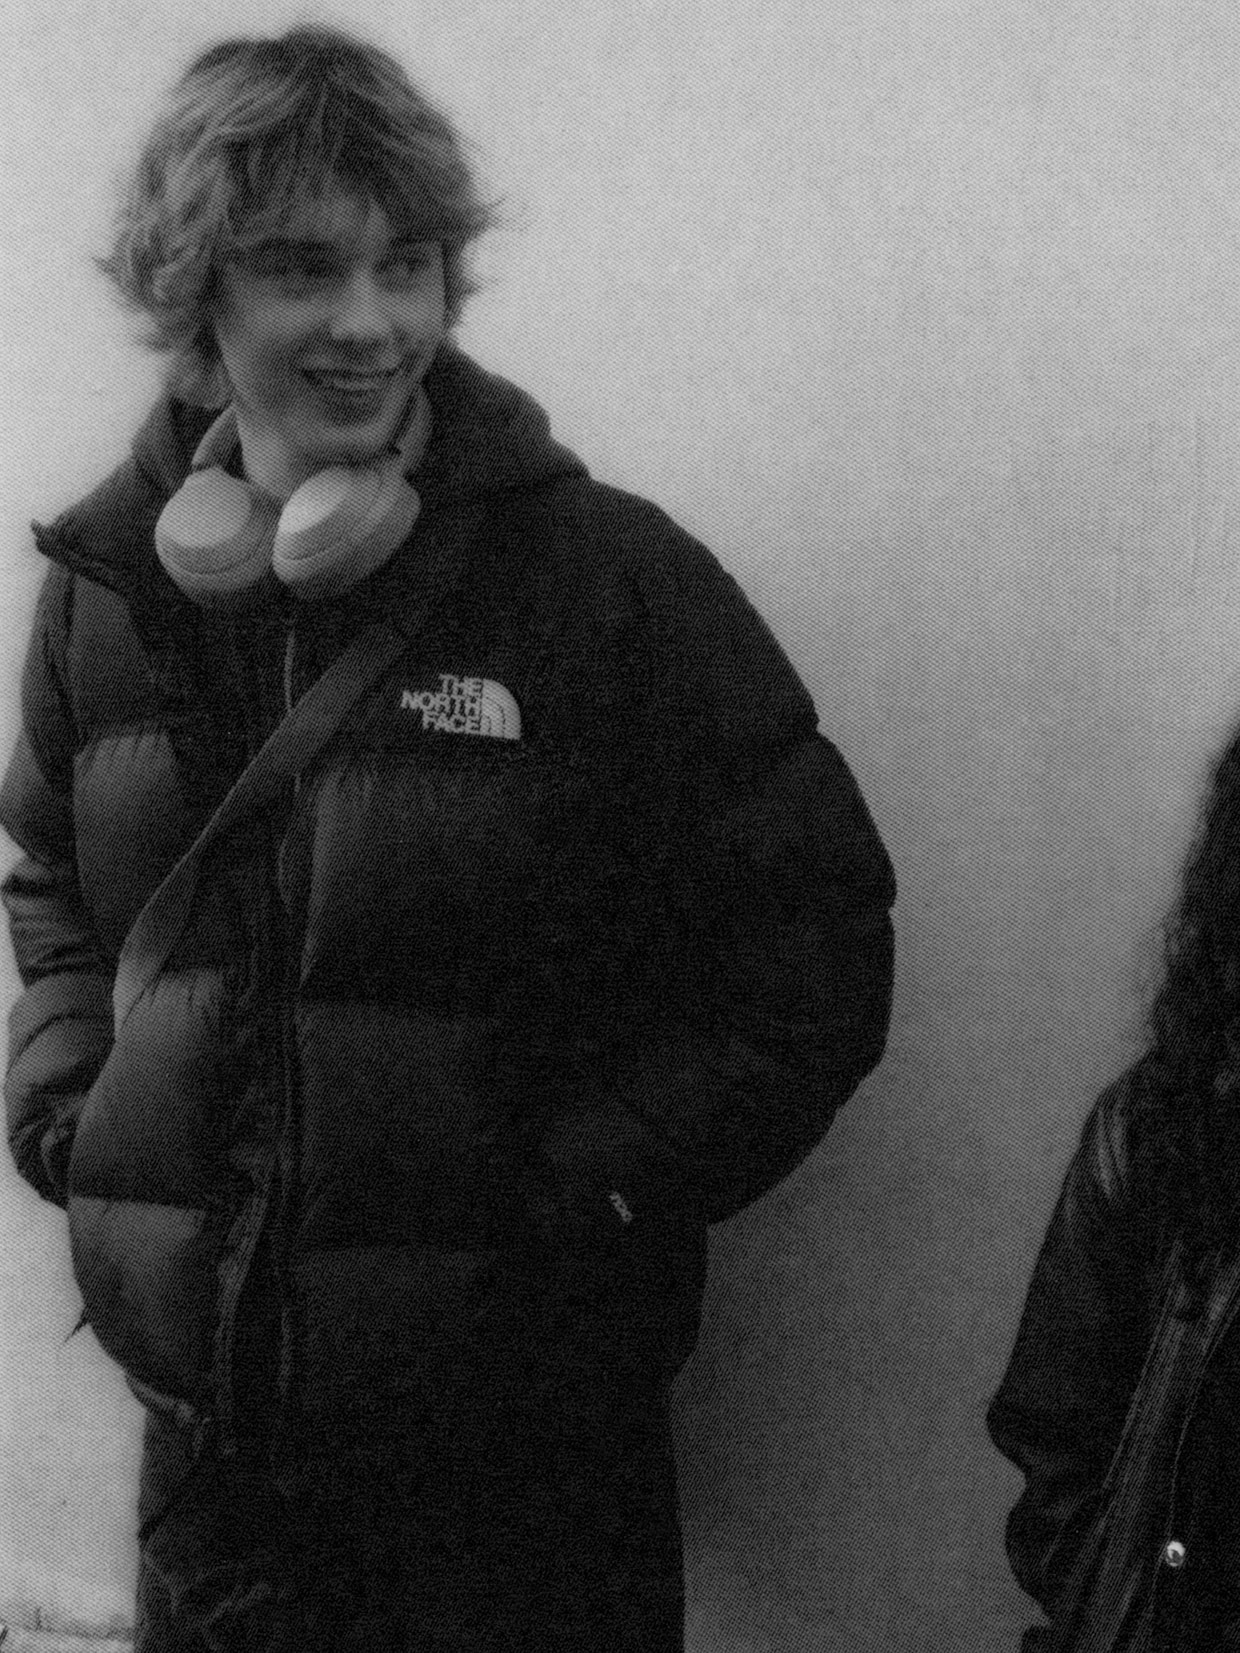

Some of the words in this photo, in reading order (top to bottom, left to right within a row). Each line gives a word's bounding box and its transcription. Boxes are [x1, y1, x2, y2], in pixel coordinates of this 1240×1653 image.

[439, 673, 482, 697] THE
[401, 690, 481, 717] NORTH
[422, 711, 481, 735] FACE
